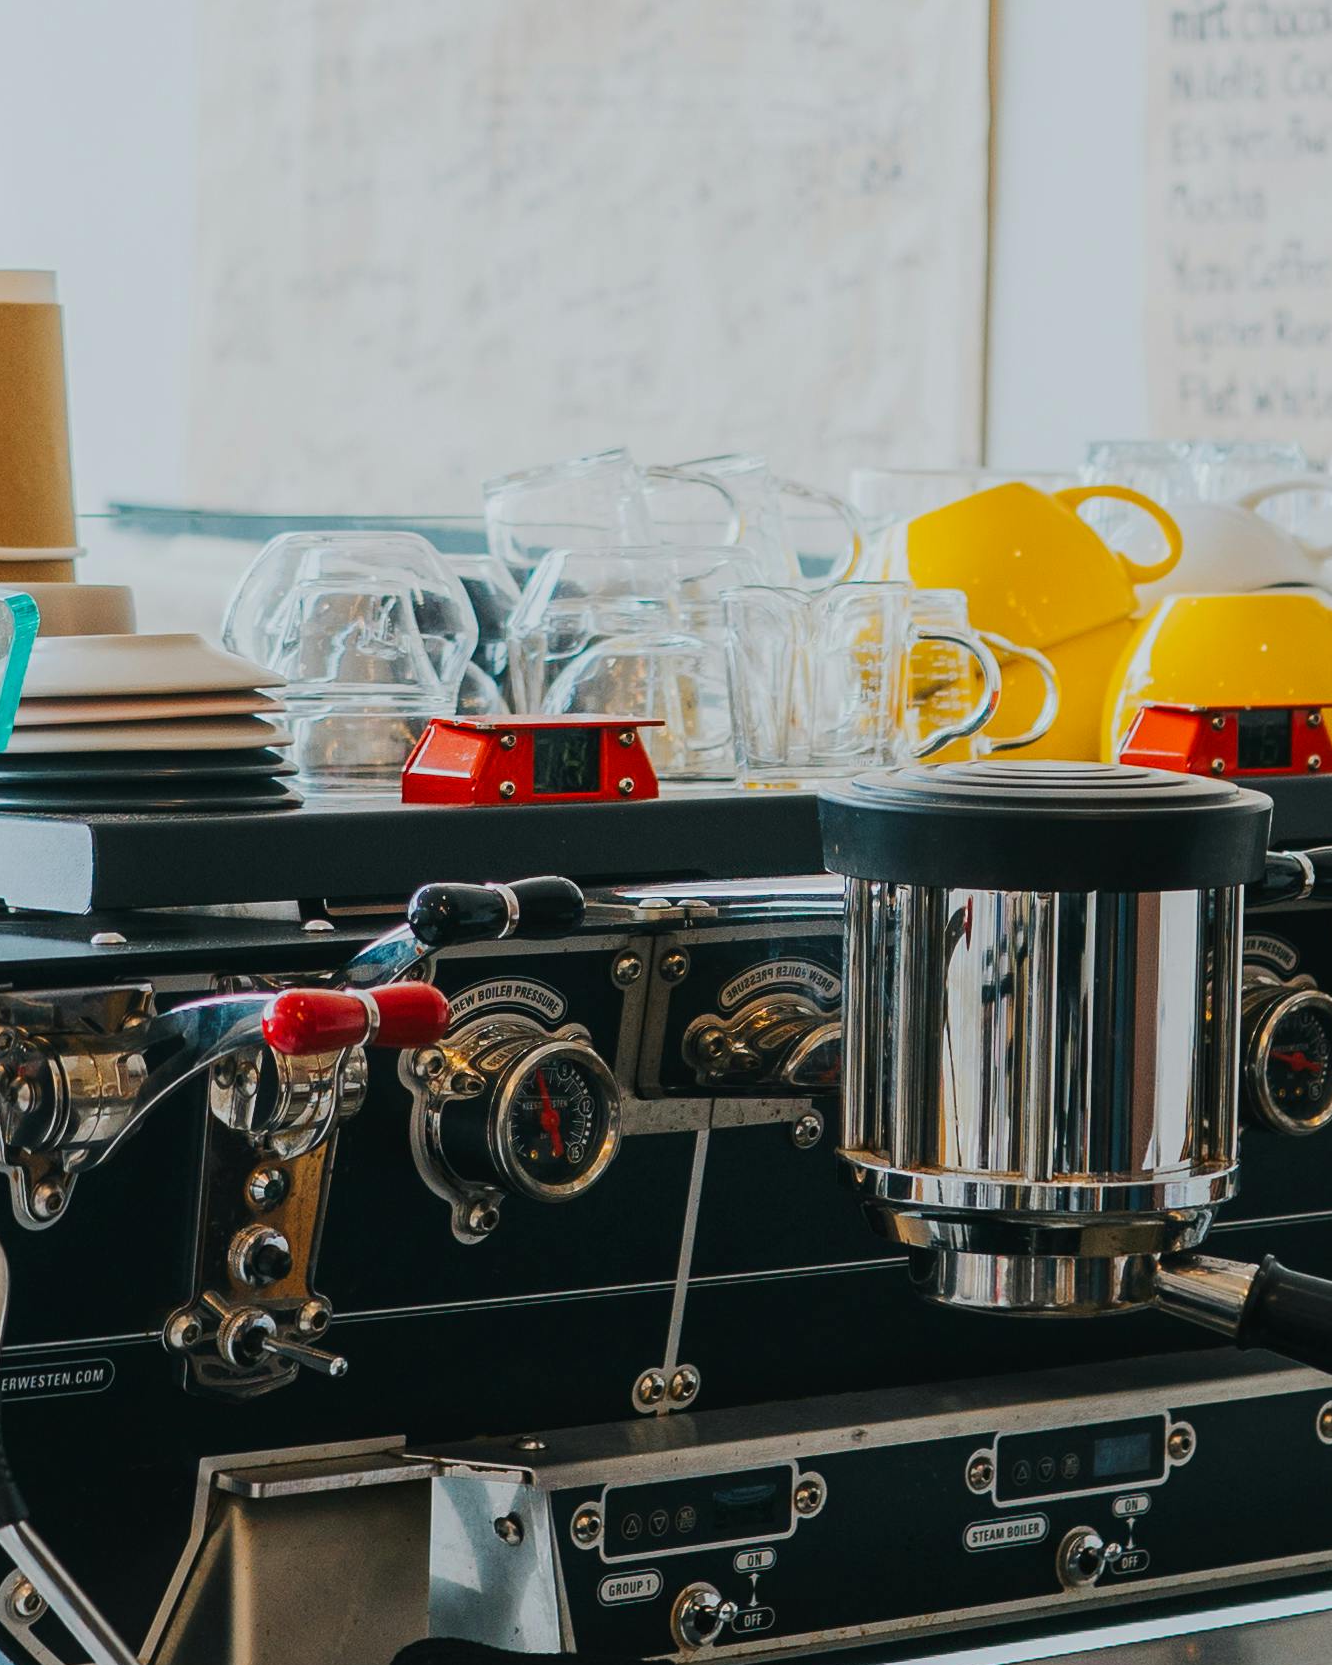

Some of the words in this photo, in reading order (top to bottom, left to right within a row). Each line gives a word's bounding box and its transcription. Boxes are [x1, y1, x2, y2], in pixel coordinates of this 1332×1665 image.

[477, 984, 512, 1002] BOILER
[513, 986, 562, 1016] PRESSURE
[581, 1099, 591, 1113] 12
[1124, 1498, 1139, 1512] ON
[972, 1526, 1005, 1544] STEAM
[1006, 1521, 1040, 1539] BOILER
[746, 1552, 763, 1568] ON
[1121, 1555, 1139, 1569] OFF
[608, 1579, 644, 1598] GROUP
[645, 1579, 652, 1592] 1
[744, 1612, 763, 1629] OFF
